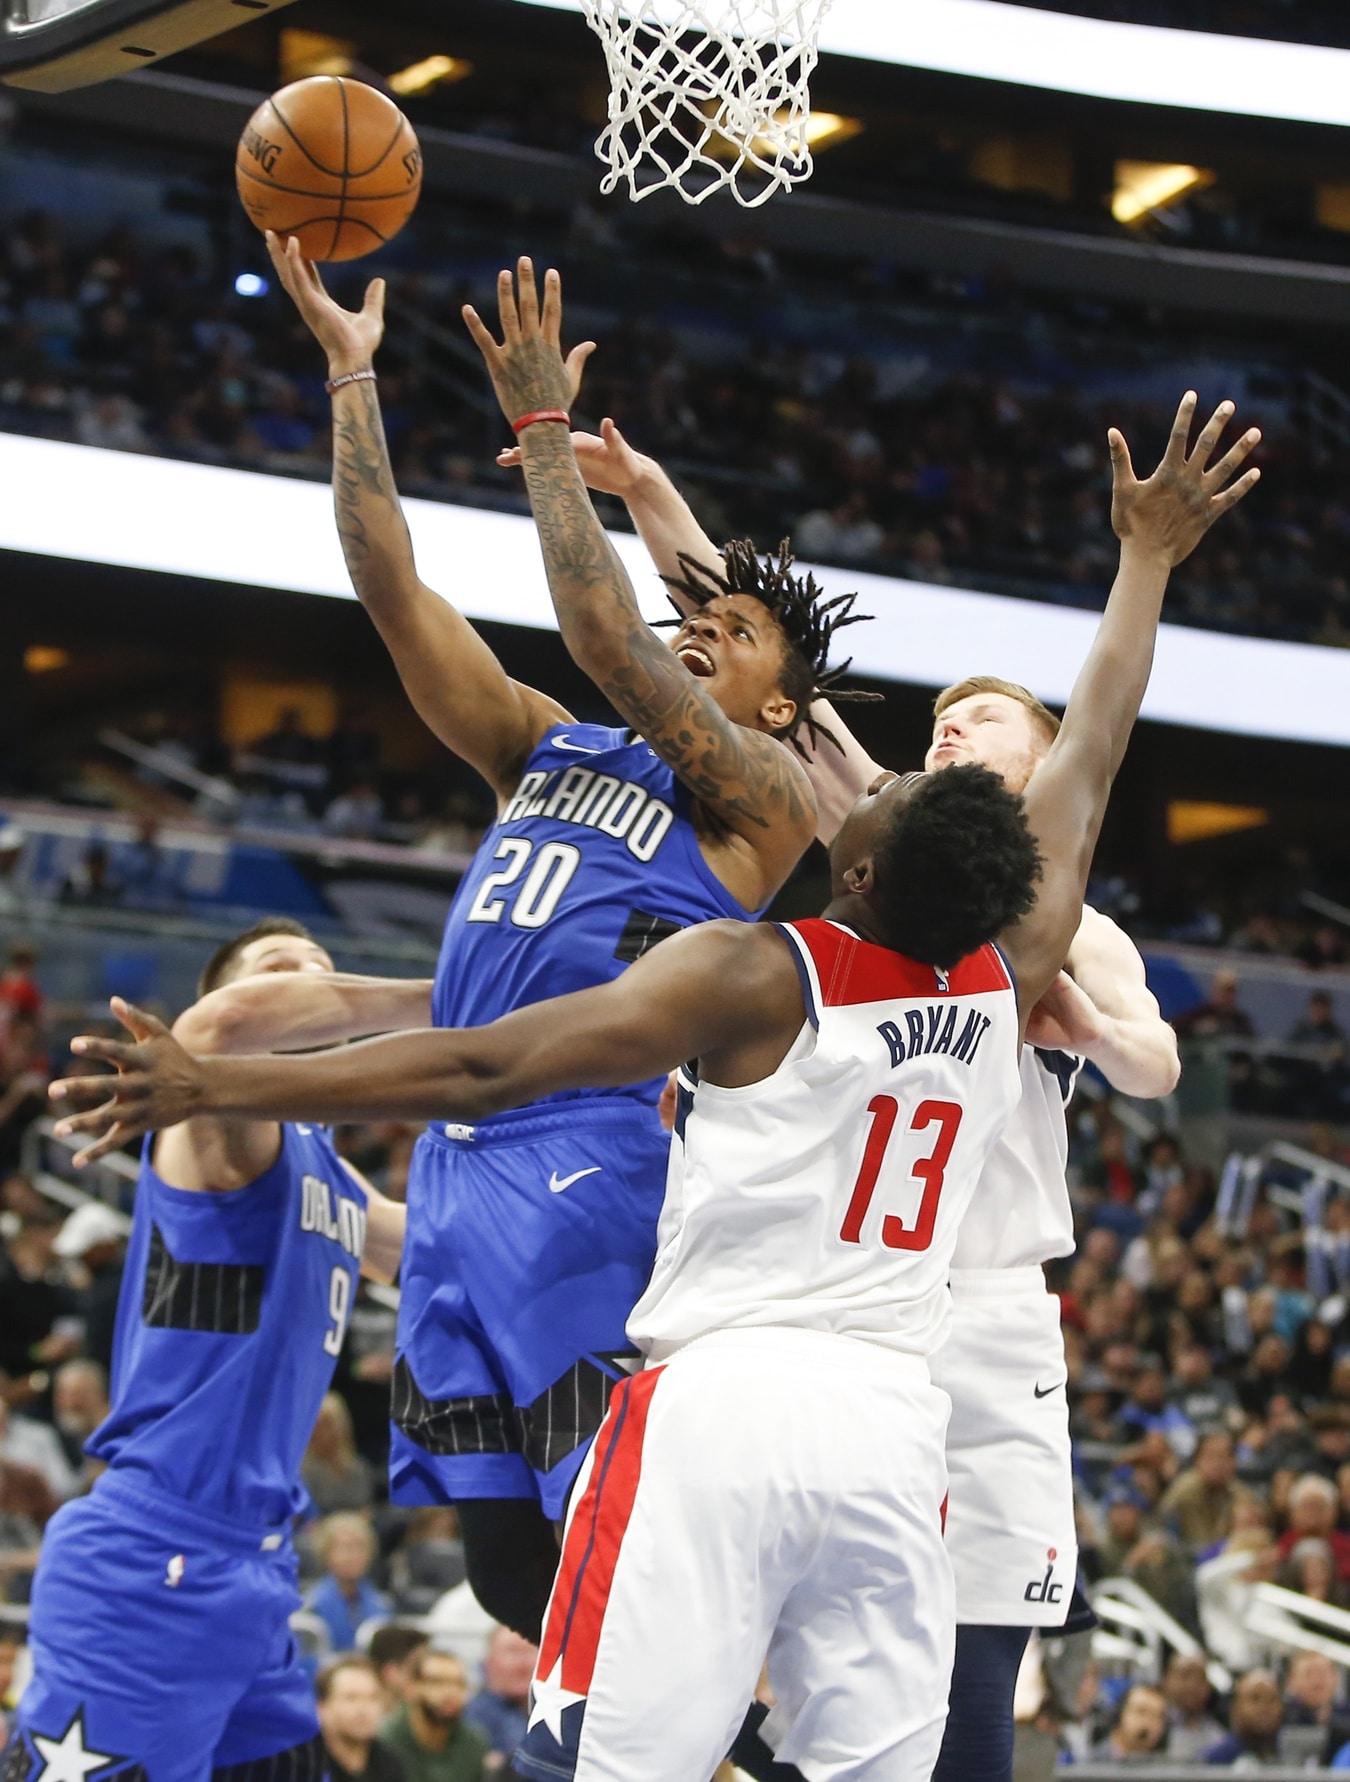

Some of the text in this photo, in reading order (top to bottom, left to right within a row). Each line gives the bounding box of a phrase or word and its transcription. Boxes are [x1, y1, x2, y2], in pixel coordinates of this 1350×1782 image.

[498, 765, 674, 863] RLANDO
[466, 836, 581, 929] 20
[876, 1004, 991, 1069] BRYANT
[840, 1094, 963, 1252] 13
[323, 1266, 351, 1357] 9
